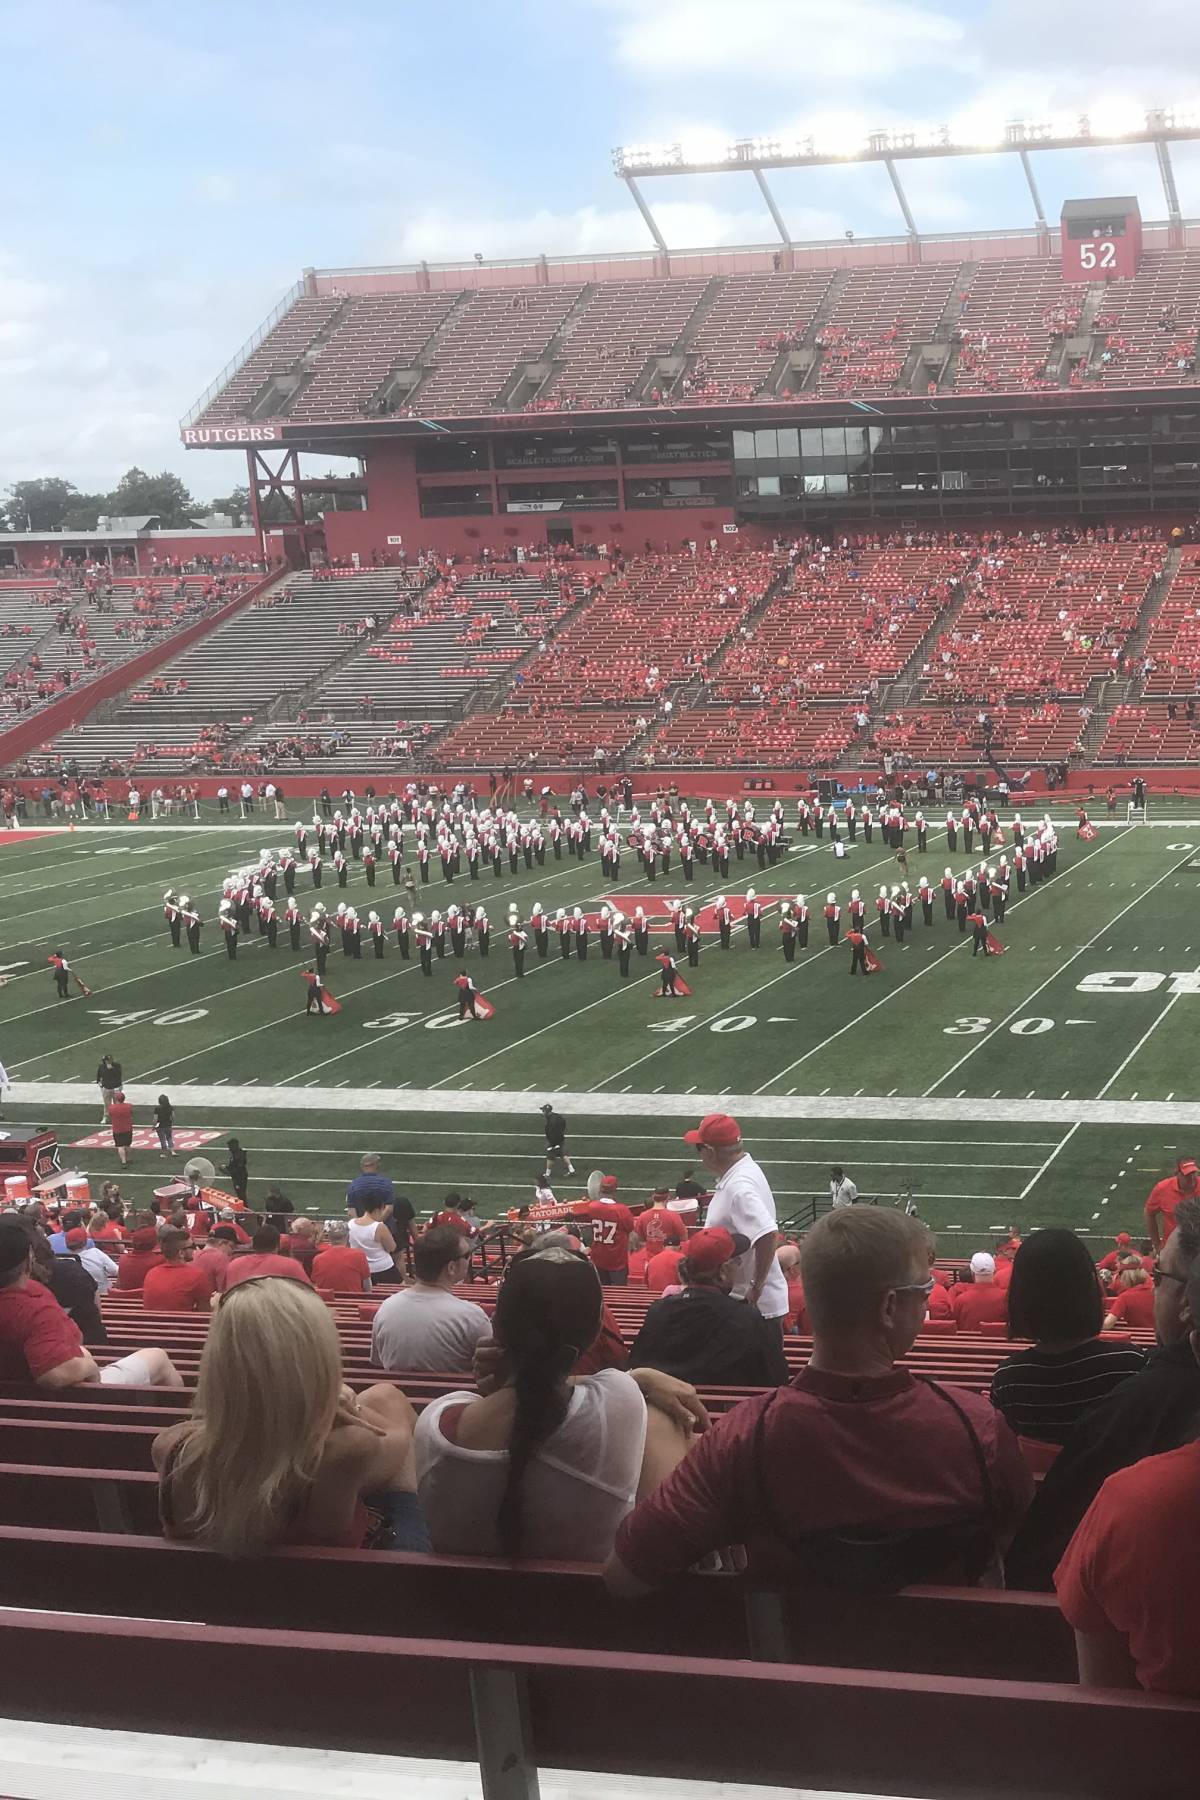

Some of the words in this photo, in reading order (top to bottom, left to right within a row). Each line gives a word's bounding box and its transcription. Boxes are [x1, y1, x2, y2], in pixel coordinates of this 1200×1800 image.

[1080, 242, 1116, 269] 52
[184, 427, 276, 443] RUTGERS
[591, 1219, 618, 1245] 27
